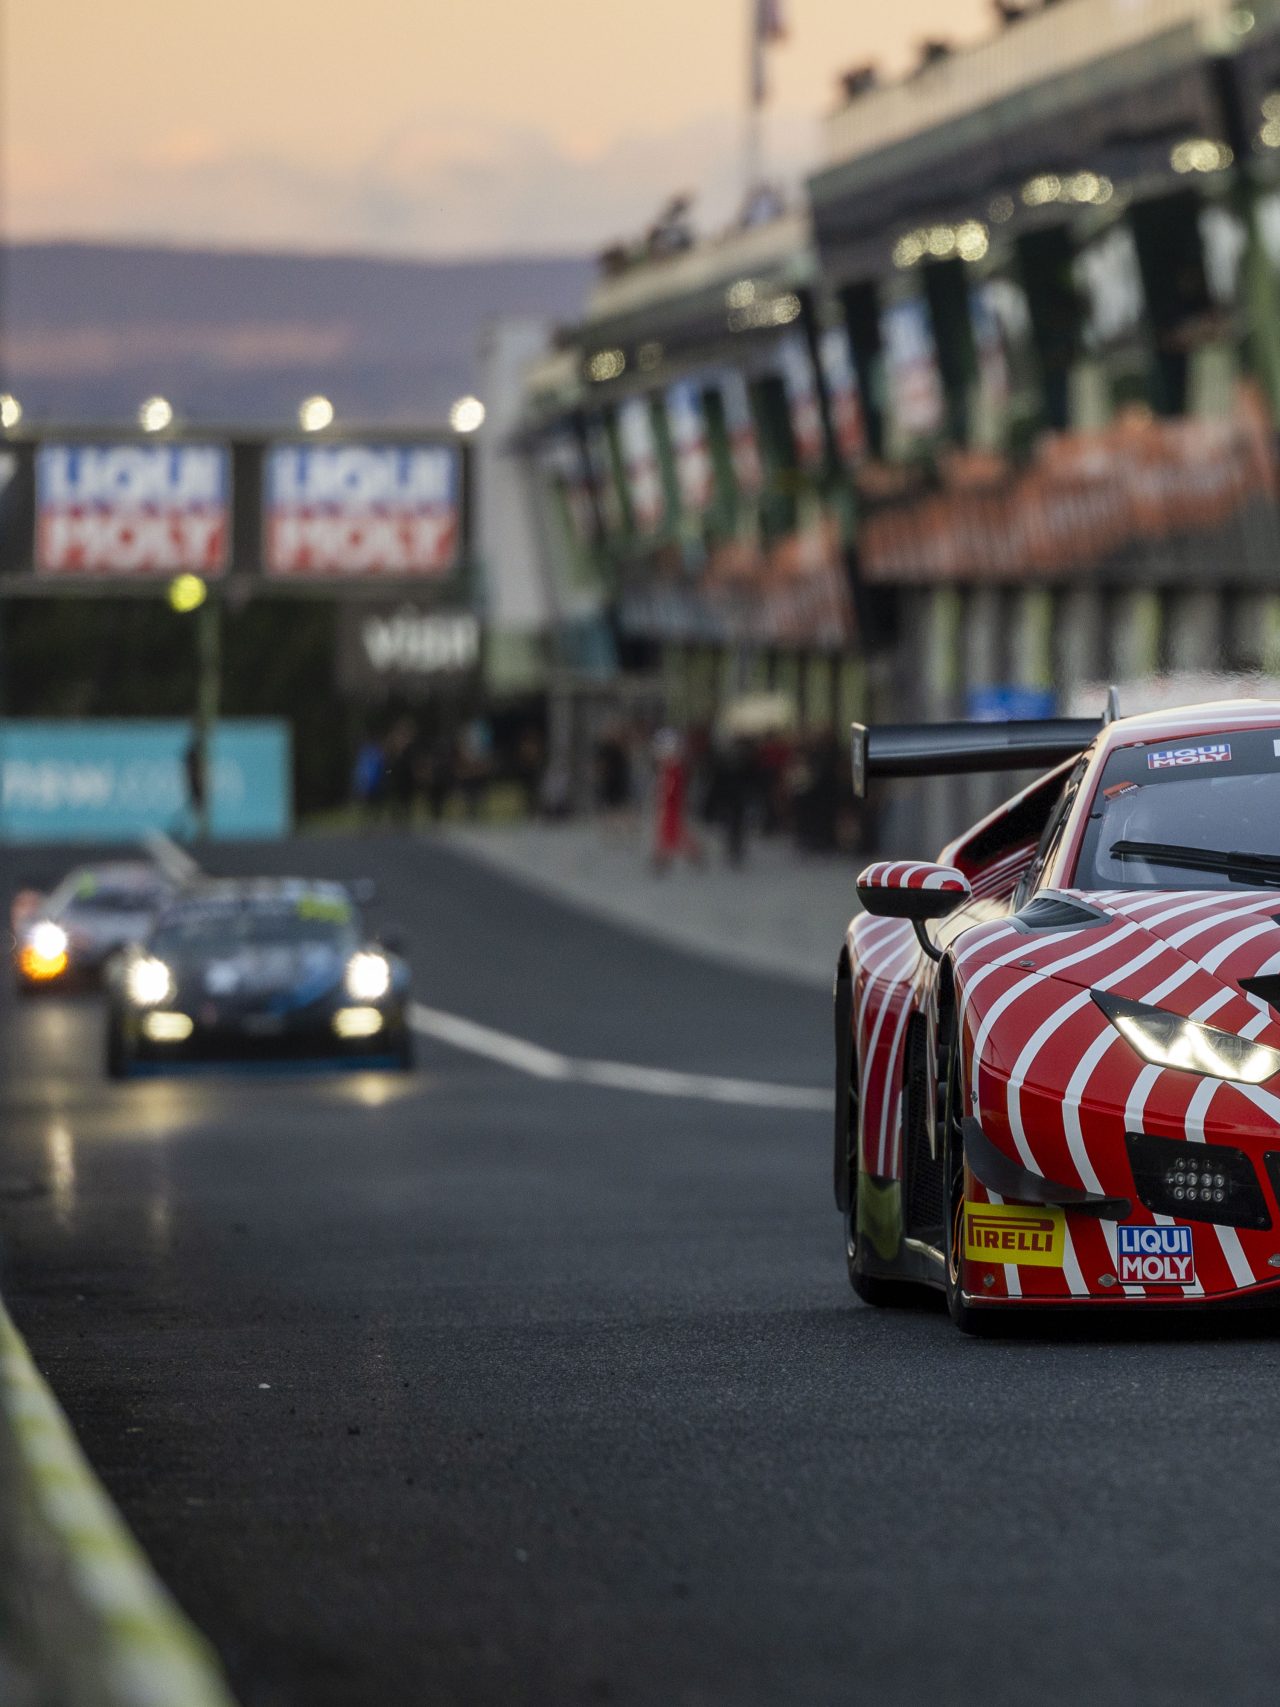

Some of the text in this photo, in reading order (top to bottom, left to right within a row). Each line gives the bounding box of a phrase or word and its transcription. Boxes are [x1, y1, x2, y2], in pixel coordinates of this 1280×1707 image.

[46, 446, 219, 502] LIQUI
[274, 446, 449, 502] LIQUI
[47, 513, 222, 570] MOLY
[275, 513, 452, 570] MOLY
[1153, 745, 1226, 760] LIQUI
[1153, 752, 1228, 768] MOLY
[968, 1213, 1055, 1252] PIRELLI
[1122, 1229, 1189, 1255] LIQUI
[1122, 1256, 1192, 1280] MOLY
